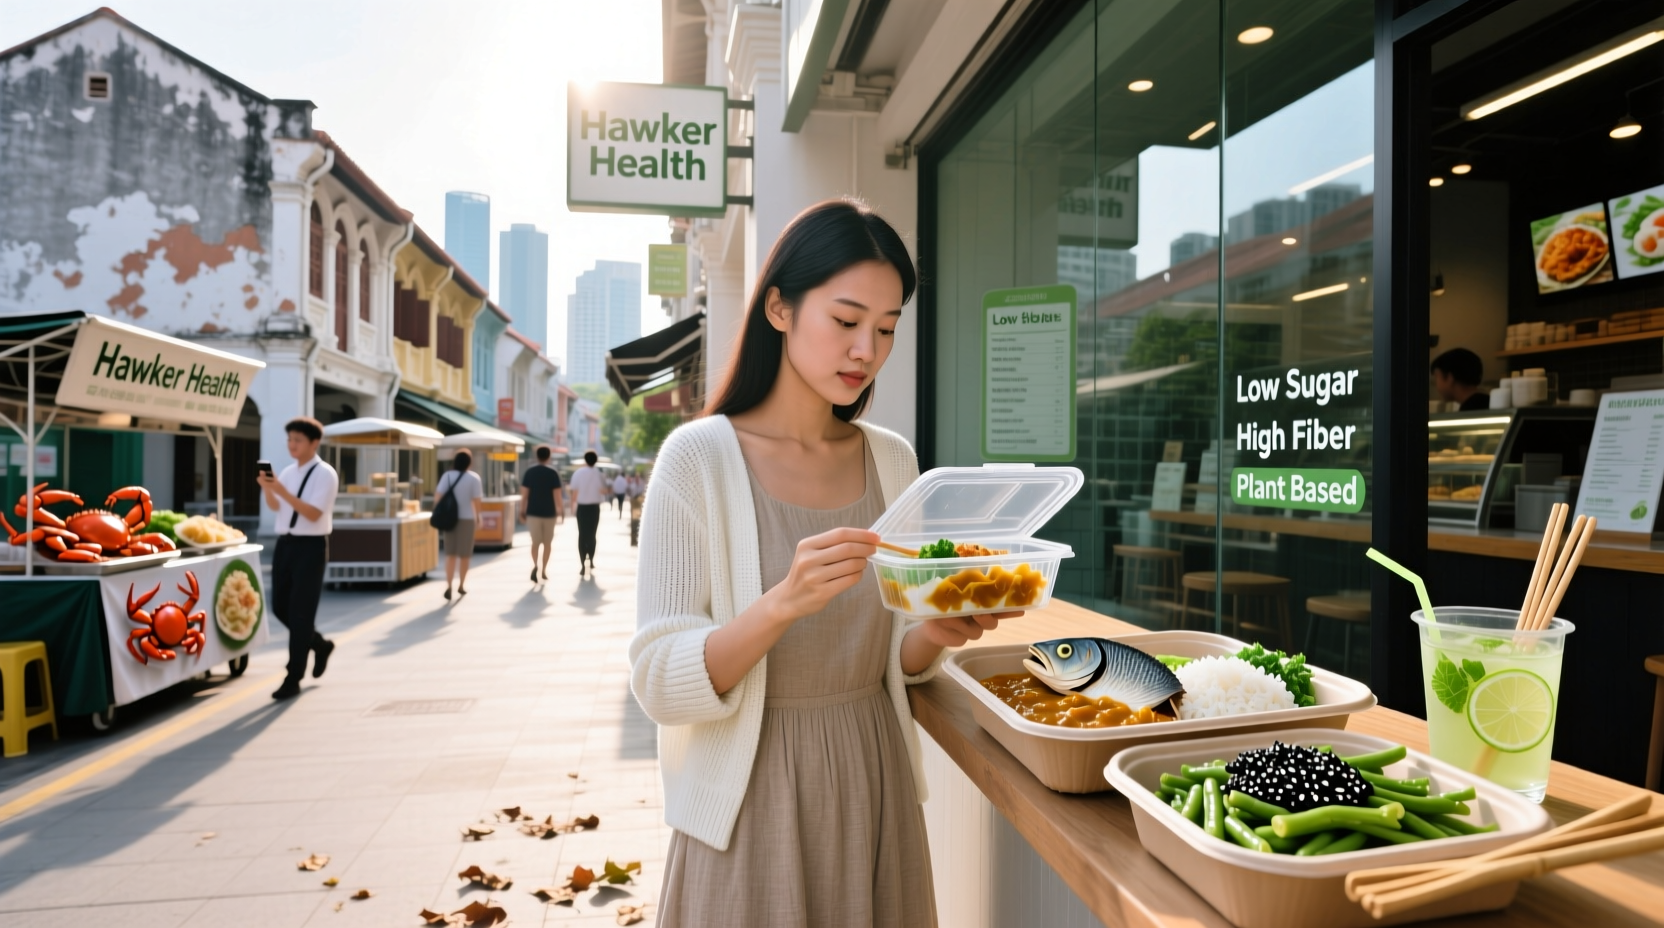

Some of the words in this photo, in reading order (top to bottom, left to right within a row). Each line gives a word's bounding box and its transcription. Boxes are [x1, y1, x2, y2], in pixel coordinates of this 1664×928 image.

[580, 109, 717, 146] Hawker
[590, 145, 706, 181] Health
[92, 341, 185, 389] Hawker
[185, 363, 240, 400] Health
[1236, 374, 1280, 403] Low
[1285, 368, 1359, 406] Sugar
[1236, 420, 1285, 459] High
[1292, 418, 1356, 450] Fiber
[1236, 473, 1286, 501] Plant
[1290, 474, 1357, 505] Based
